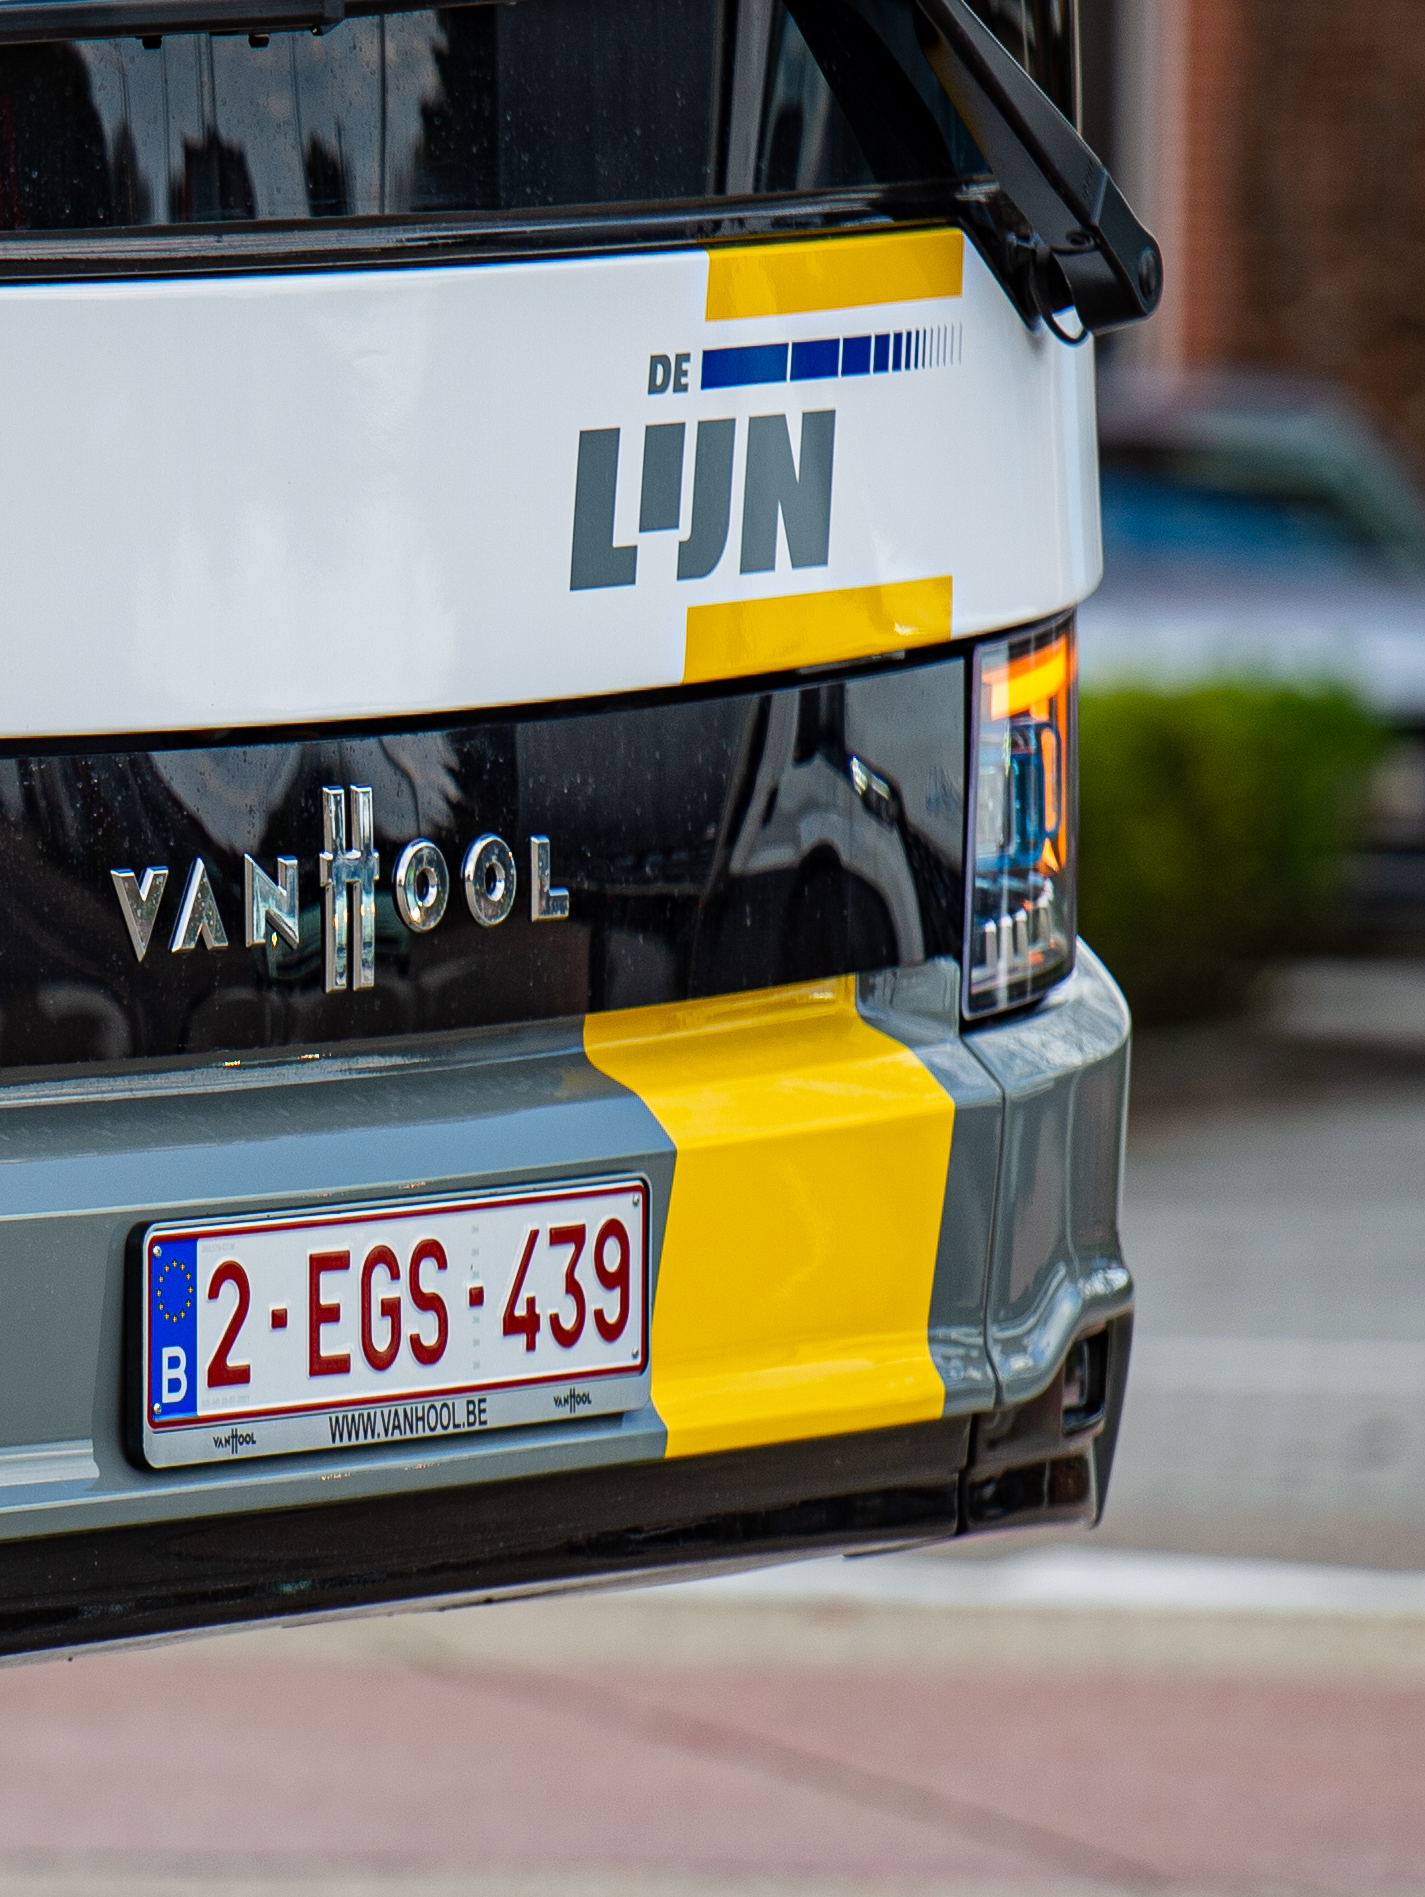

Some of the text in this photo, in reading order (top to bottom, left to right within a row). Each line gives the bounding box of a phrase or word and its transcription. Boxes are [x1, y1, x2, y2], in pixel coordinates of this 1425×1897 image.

[647, 351, 692, 396] DE
[569, 408, 837, 593] LIJN
[206, 1216, 631, 1389] 2-EGS-439
[160, 1345, 189, 1405] B
[328, 1396, 488, 1445] WWW.VANHOOL.BE
